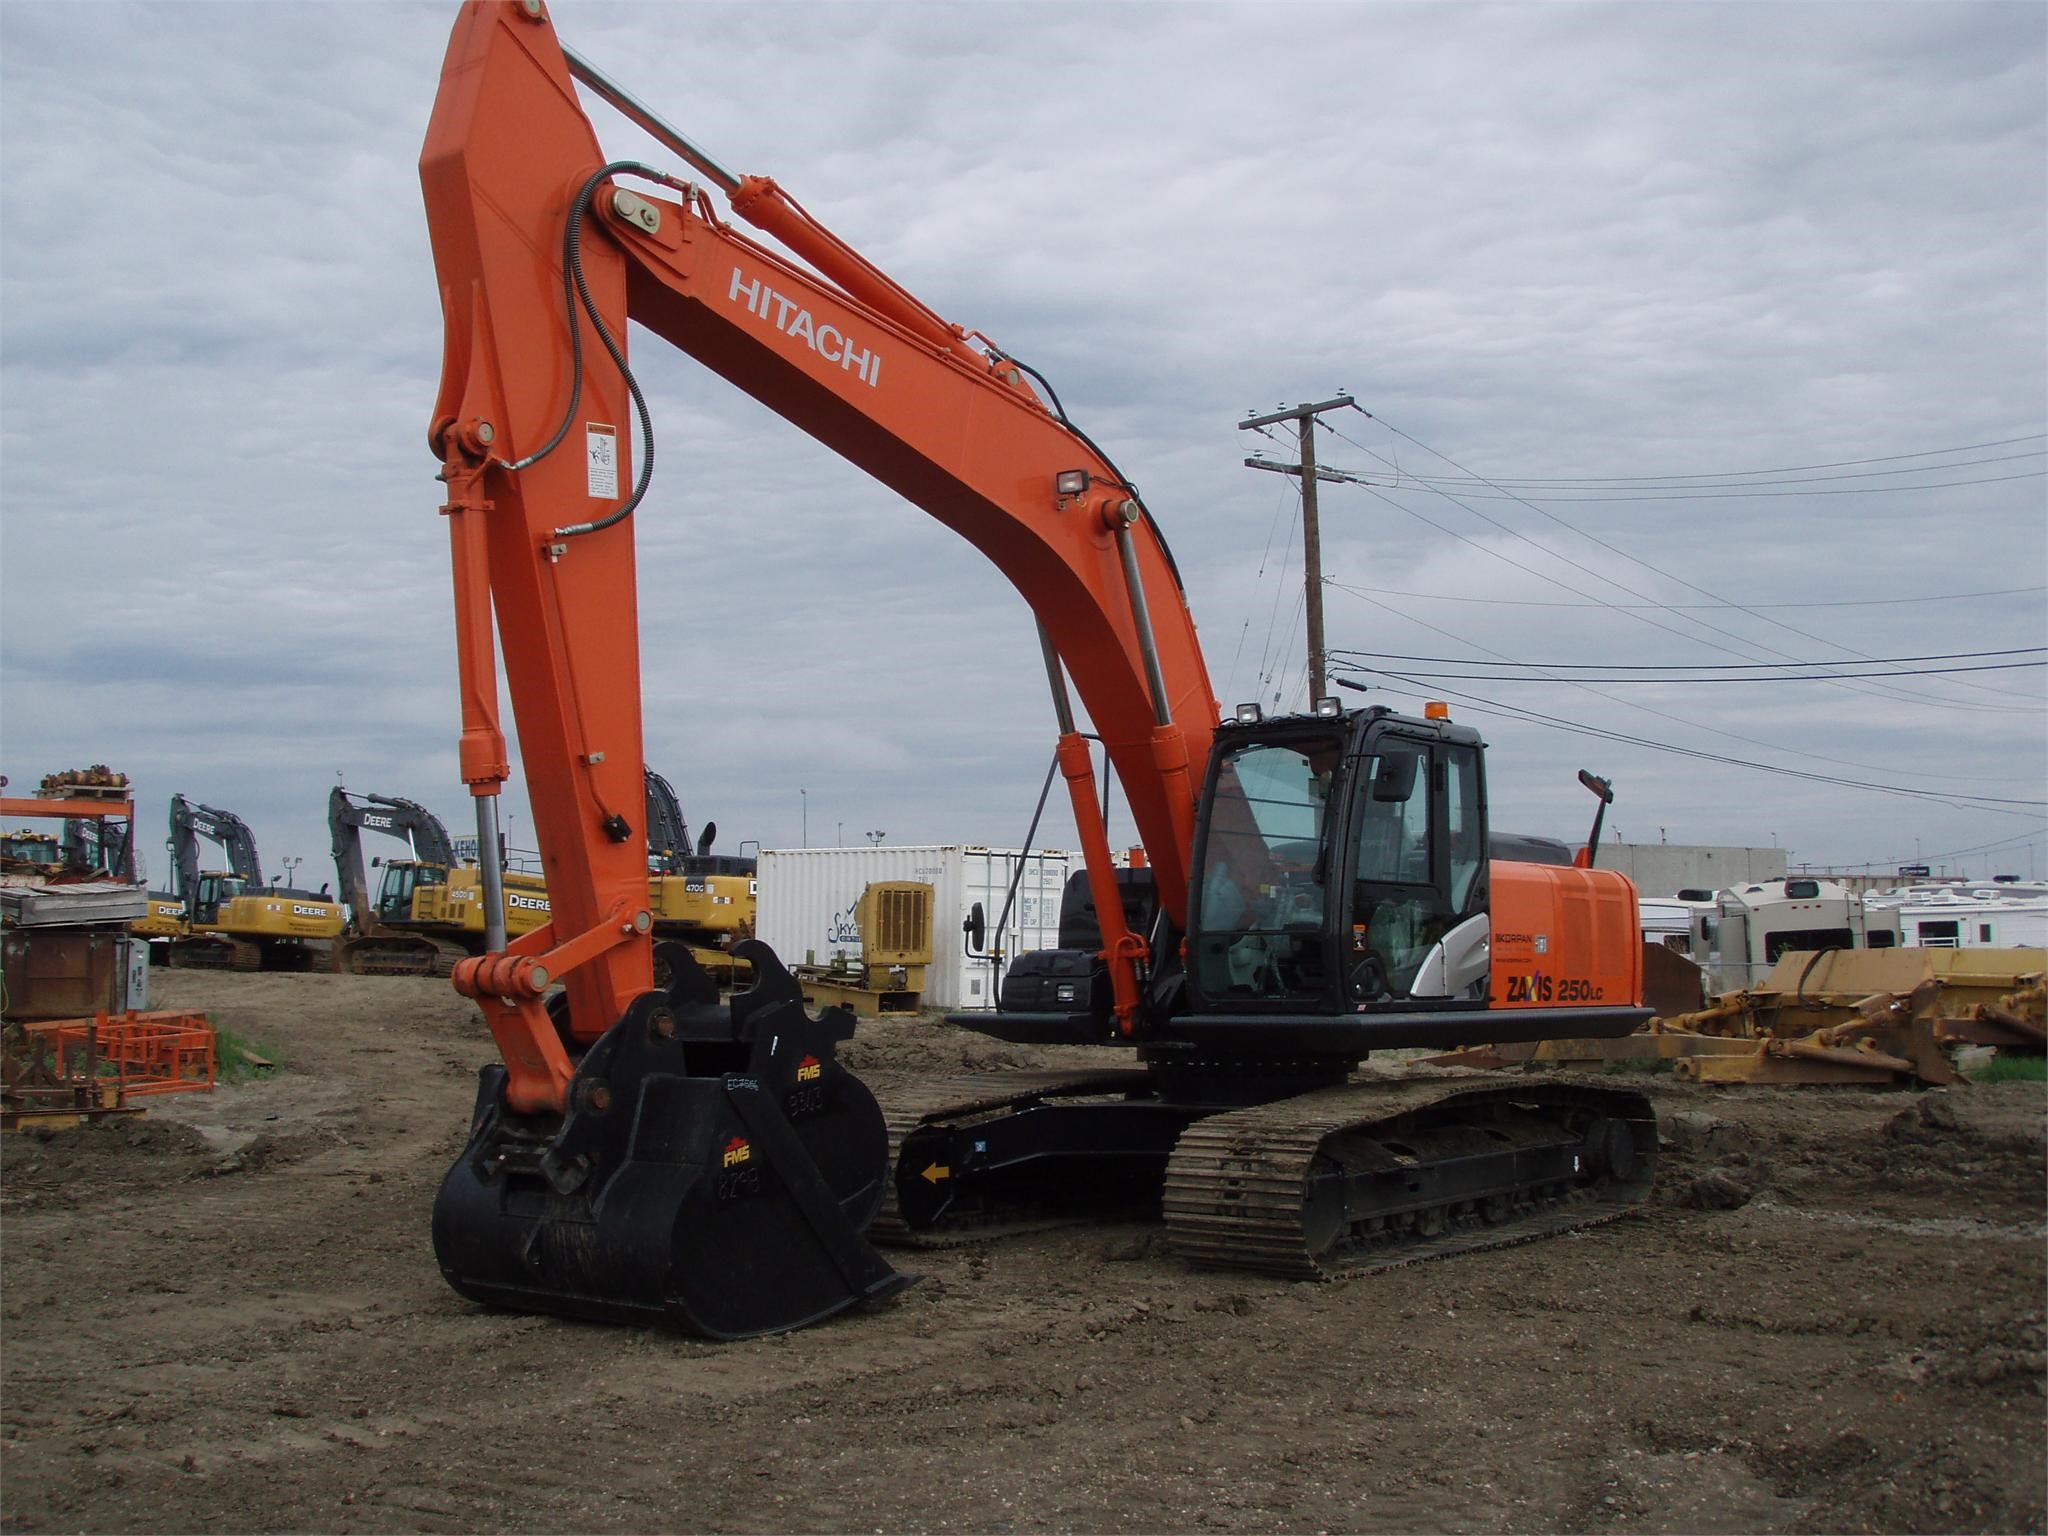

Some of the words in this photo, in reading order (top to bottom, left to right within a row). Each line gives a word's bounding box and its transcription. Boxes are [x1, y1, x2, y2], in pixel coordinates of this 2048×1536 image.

[729, 267, 881, 388] HITACHI
[193, 818, 216, 835] DEERE
[364, 813, 393, 828] DEERE
[158, 906, 184, 916] DEER
[293, 905, 327, 917] DEERE
[1507, 970, 1553, 1002] ZAXIS
[798, 1064, 821, 1082] FMS
[724, 1145, 749, 1167] FMS
